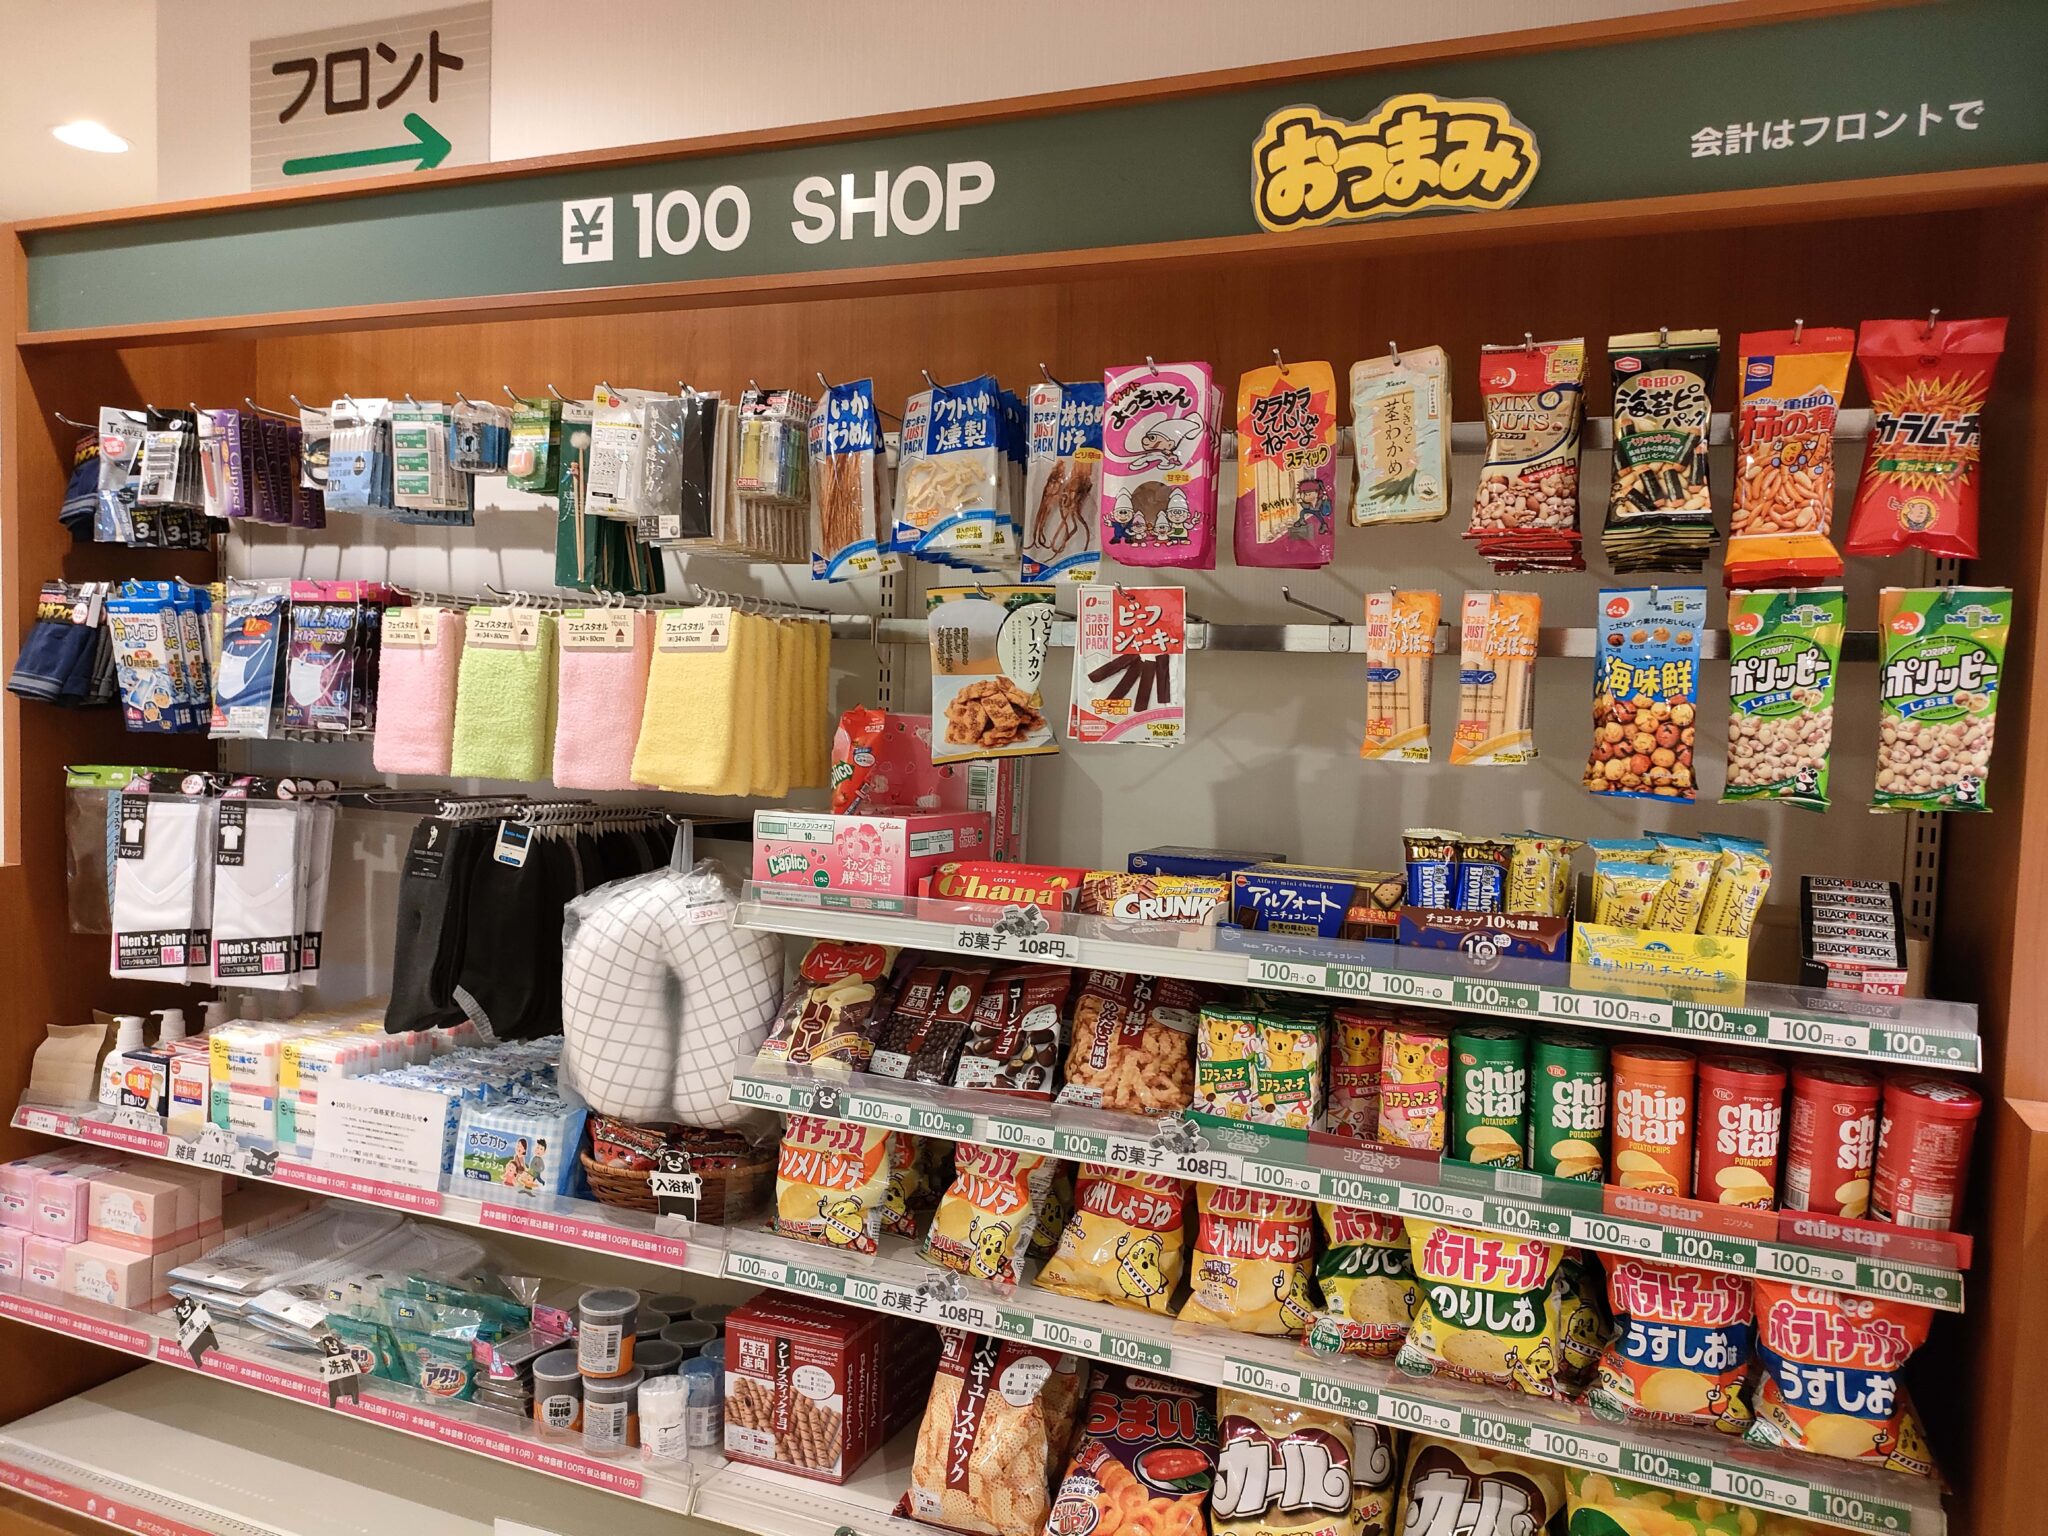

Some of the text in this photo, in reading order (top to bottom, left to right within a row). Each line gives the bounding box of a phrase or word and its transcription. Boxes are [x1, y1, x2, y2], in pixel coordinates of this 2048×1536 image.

[271, 30, 465, 124] フロント
[1689, 98, 1987, 159] 会計はフロントで
[1259, 103, 1529, 226] おつまみ
[632, 185, 751, 259] 100
[791, 160, 996, 244] SHOP
[1637, 375, 1686, 388] 亀田の
[831, 390, 869, 418] いか
[1110, 387, 1192, 430] よっちゃん
[1250, 386, 1313, 417] タラタラ
[1488, 395, 1536, 413] MIX
[1615, 384, 1705, 419] 海苔ピー
[1783, 394, 1835, 409] 亀田の
[1033, 424, 1054, 438] JUST
[1252, 408, 1320, 436] してんじゃ
[1489, 413, 1550, 432] NUTS
[1662, 410, 1706, 429] パック
[1741, 405, 1838, 447] 柿の種
[828, 419, 872, 449] そうめん
[904, 424, 926, 442] JUST
[936, 419, 988, 453] 燻製
[1384, 399, 1404, 476] 茎わかめ
[904, 440, 924, 456] PACK
[1033, 437, 1055, 453] PACK
[227, 412, 241, 510] Nail Clipper
[1285, 446, 1328, 470] スティック
[387, 621, 420, 631] フェイスタオル
[473, 619, 515, 631] フェイスタオル
[567, 621, 610, 634] フェイスタオル
[665, 621, 706, 634] フェイスタオル
[1118, 604, 1163, 628] ビーフ
[1488, 611, 1523, 633] チーズ
[1085, 623, 1109, 638] JUST
[1114, 627, 1180, 653] ジャーキー
[1368, 624, 1388, 637] JUST
[1464, 625, 1485, 638] JUST
[1027, 614, 1041, 683] ソースカツ
[1085, 637, 1109, 651] PACK
[1602, 655, 1694, 698] 海味鮮
[1730, 648, 1831, 696] ポリッピー
[1884, 649, 1999, 698] ポリッピー
[1750, 692, 1789, 709] しお味
[1909, 695, 1952, 712] しお味
[768, 855, 810, 875] Caplico
[938, 875, 1054, 908] Ghana
[992, 877, 1017, 886] LOTTE
[1814, 877, 1885, 890] BLACK BLACK
[1112, 893, 1217, 923] CRUNKY
[1247, 886, 1342, 913] アルフォート
[1816, 893, 1888, 907] BLACK BLACK
[1264, 911, 1325, 923] ミニチョコレート
[1426, 912, 1484, 927] チョコチップ
[1818, 909, 1890, 924] BLACK BLACK
[119, 933, 187, 948] Men's T-shirt
[957, 929, 1066, 959] お菓子 108円
[1817, 925, 1889, 940] BLACK BLACK
[219, 940, 288, 955] Men's T-shirt
[1818, 943, 1891, 958] BLACK BLACK
[1862, 982, 1901, 997] No.1
[915, 984, 947, 1038] ムギチョコ
[995, 986, 1023, 1056] コーンチョコ
[1090, 1000, 1120, 1071] めんたいこ風味
[1201, 1067, 1246, 1083] コアラのマーチ
[1258, 1077, 1306, 1094] コアラのマーチ
[1464, 1065, 1526, 1094] chip
[1385, 1090, 1439, 1108] コアラのマーチ
[1464, 1090, 1526, 1117] star
[1616, 1090, 1687, 1121] chip
[1233, 1122, 1255, 1130] LOTTE
[1616, 1113, 1686, 1146] star
[1718, 1102, 1782, 1134] chip
[468, 1131, 508, 1150] おでかけ
[1361, 1143, 1384, 1151] LOTTE
[1717, 1129, 1780, 1158] star
[175, 1143, 232, 1169] 雑貨 110円
[471, 1157, 504, 1171] ティッシュ
[472, 1148, 500, 1159] ウェット
[1110, 1142, 1229, 1180] お菓子 108円
[655, 1179, 695, 1195] 入浴剤
[1210, 1218, 1312, 1258] 九州しょうゆ
[1794, 1219, 1891, 1247] chip star
[1422, 1225, 1552, 1291] ポテトチップス
[1611, 1260, 1756, 1326] ポテトチップス
[880, 1288, 985, 1328] お菓子 108円
[1430, 1285, 1538, 1333] のりしお
[1768, 1299, 1913, 1369] ポテトチップス
[742, 1341, 766, 1357] 生活
[328, 1359, 356, 1376] 洗剤
[740, 1355, 767, 1372] 志向
[424, 1367, 460, 1387] アタック
[776, 1340, 789, 1432] クレープスティックチョコ
[1779, 1361, 1899, 1417] うすしお
[1772, 1407, 1792, 1430] 60g
[1212, 1441, 1352, 1519] カール
